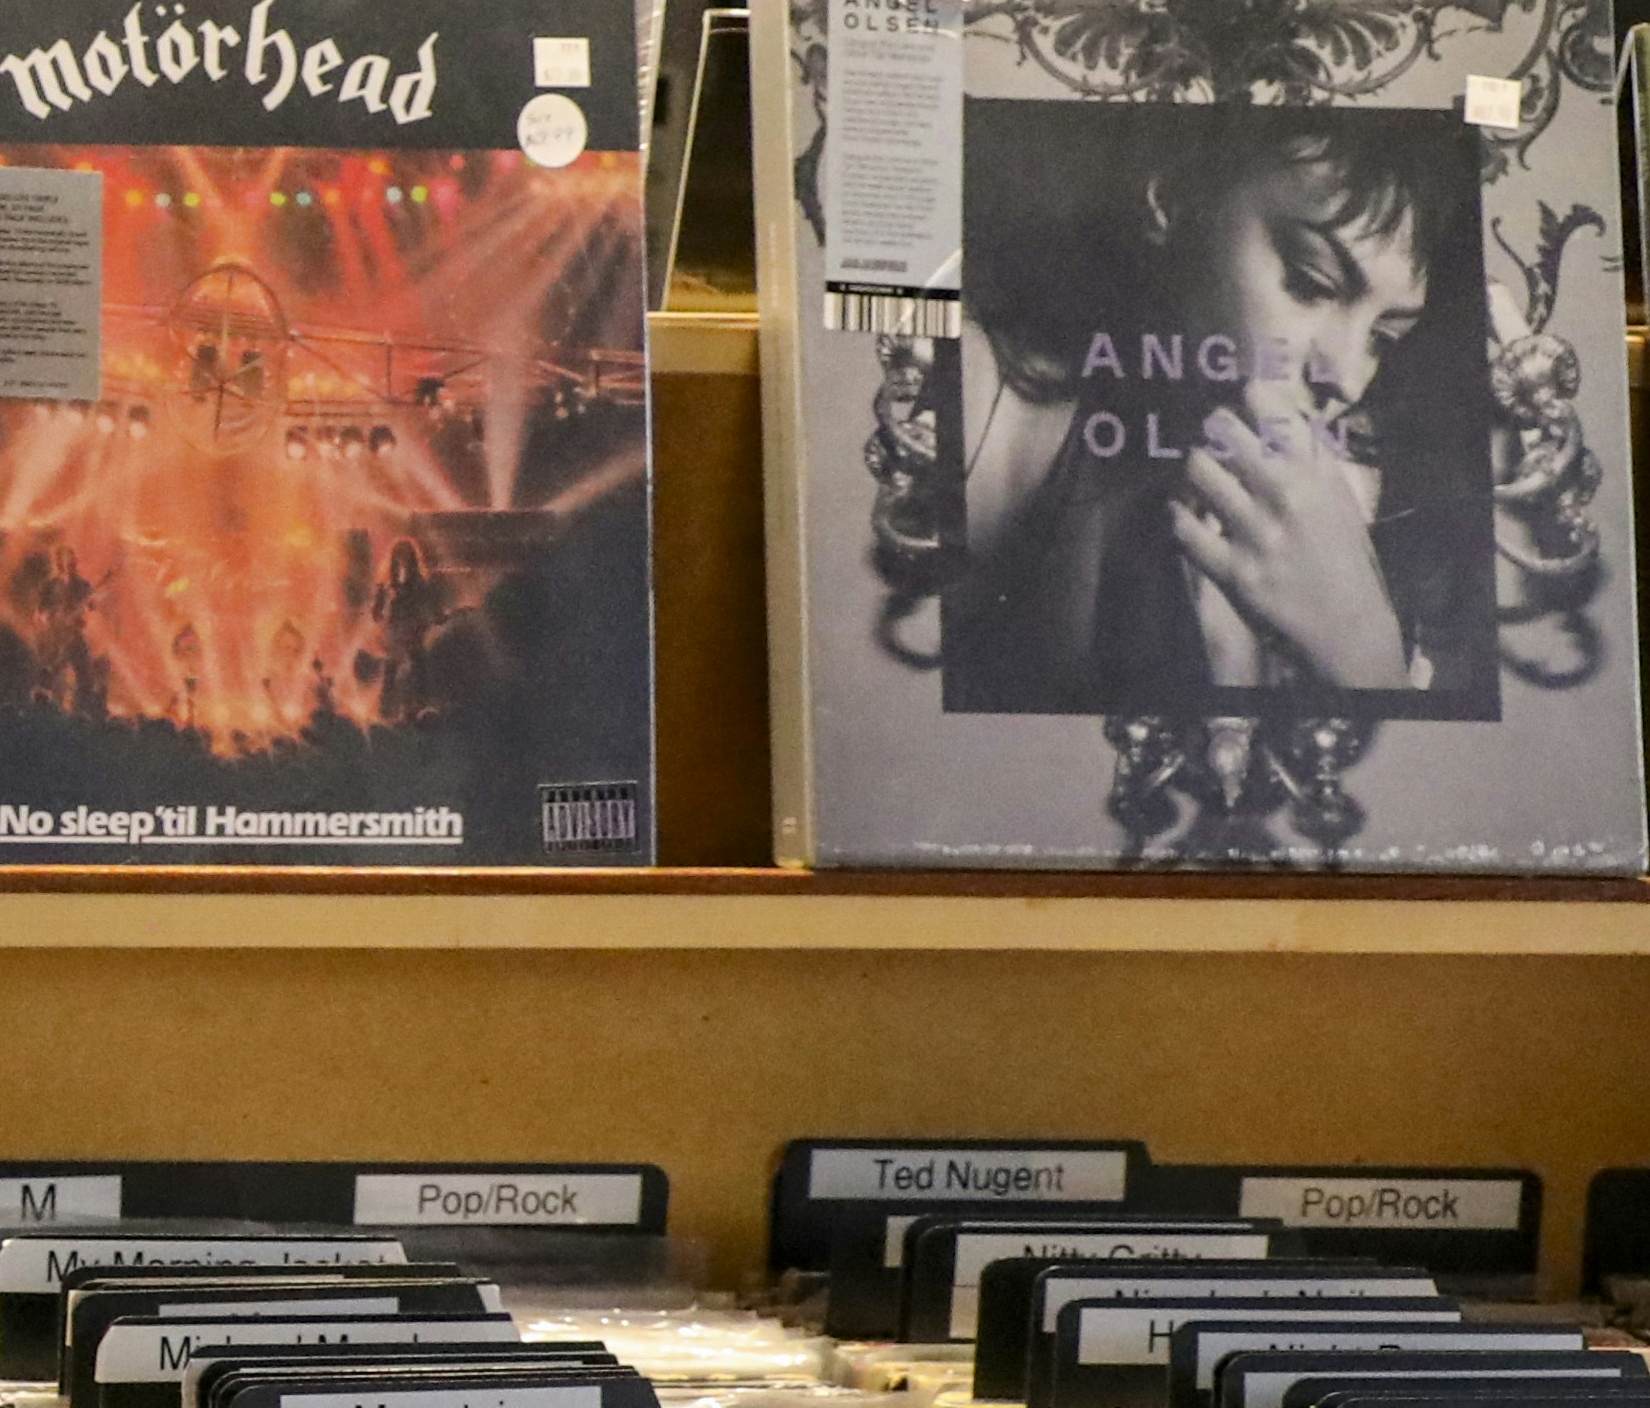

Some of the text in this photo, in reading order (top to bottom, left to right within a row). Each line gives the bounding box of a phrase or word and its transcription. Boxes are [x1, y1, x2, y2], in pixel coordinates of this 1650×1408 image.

[1083, 409, 1351, 463] OLSEN
[57, 806, 151, 846] sleep
[204, 806, 464, 839] Hammersmith
[873, 1159, 1064, 1197] Ted Nugent
[21, 1184, 57, 1217] M
[417, 1183, 579, 1218] Pop/Rock
[1300, 1186, 1458, 1223] Pop/Rock
